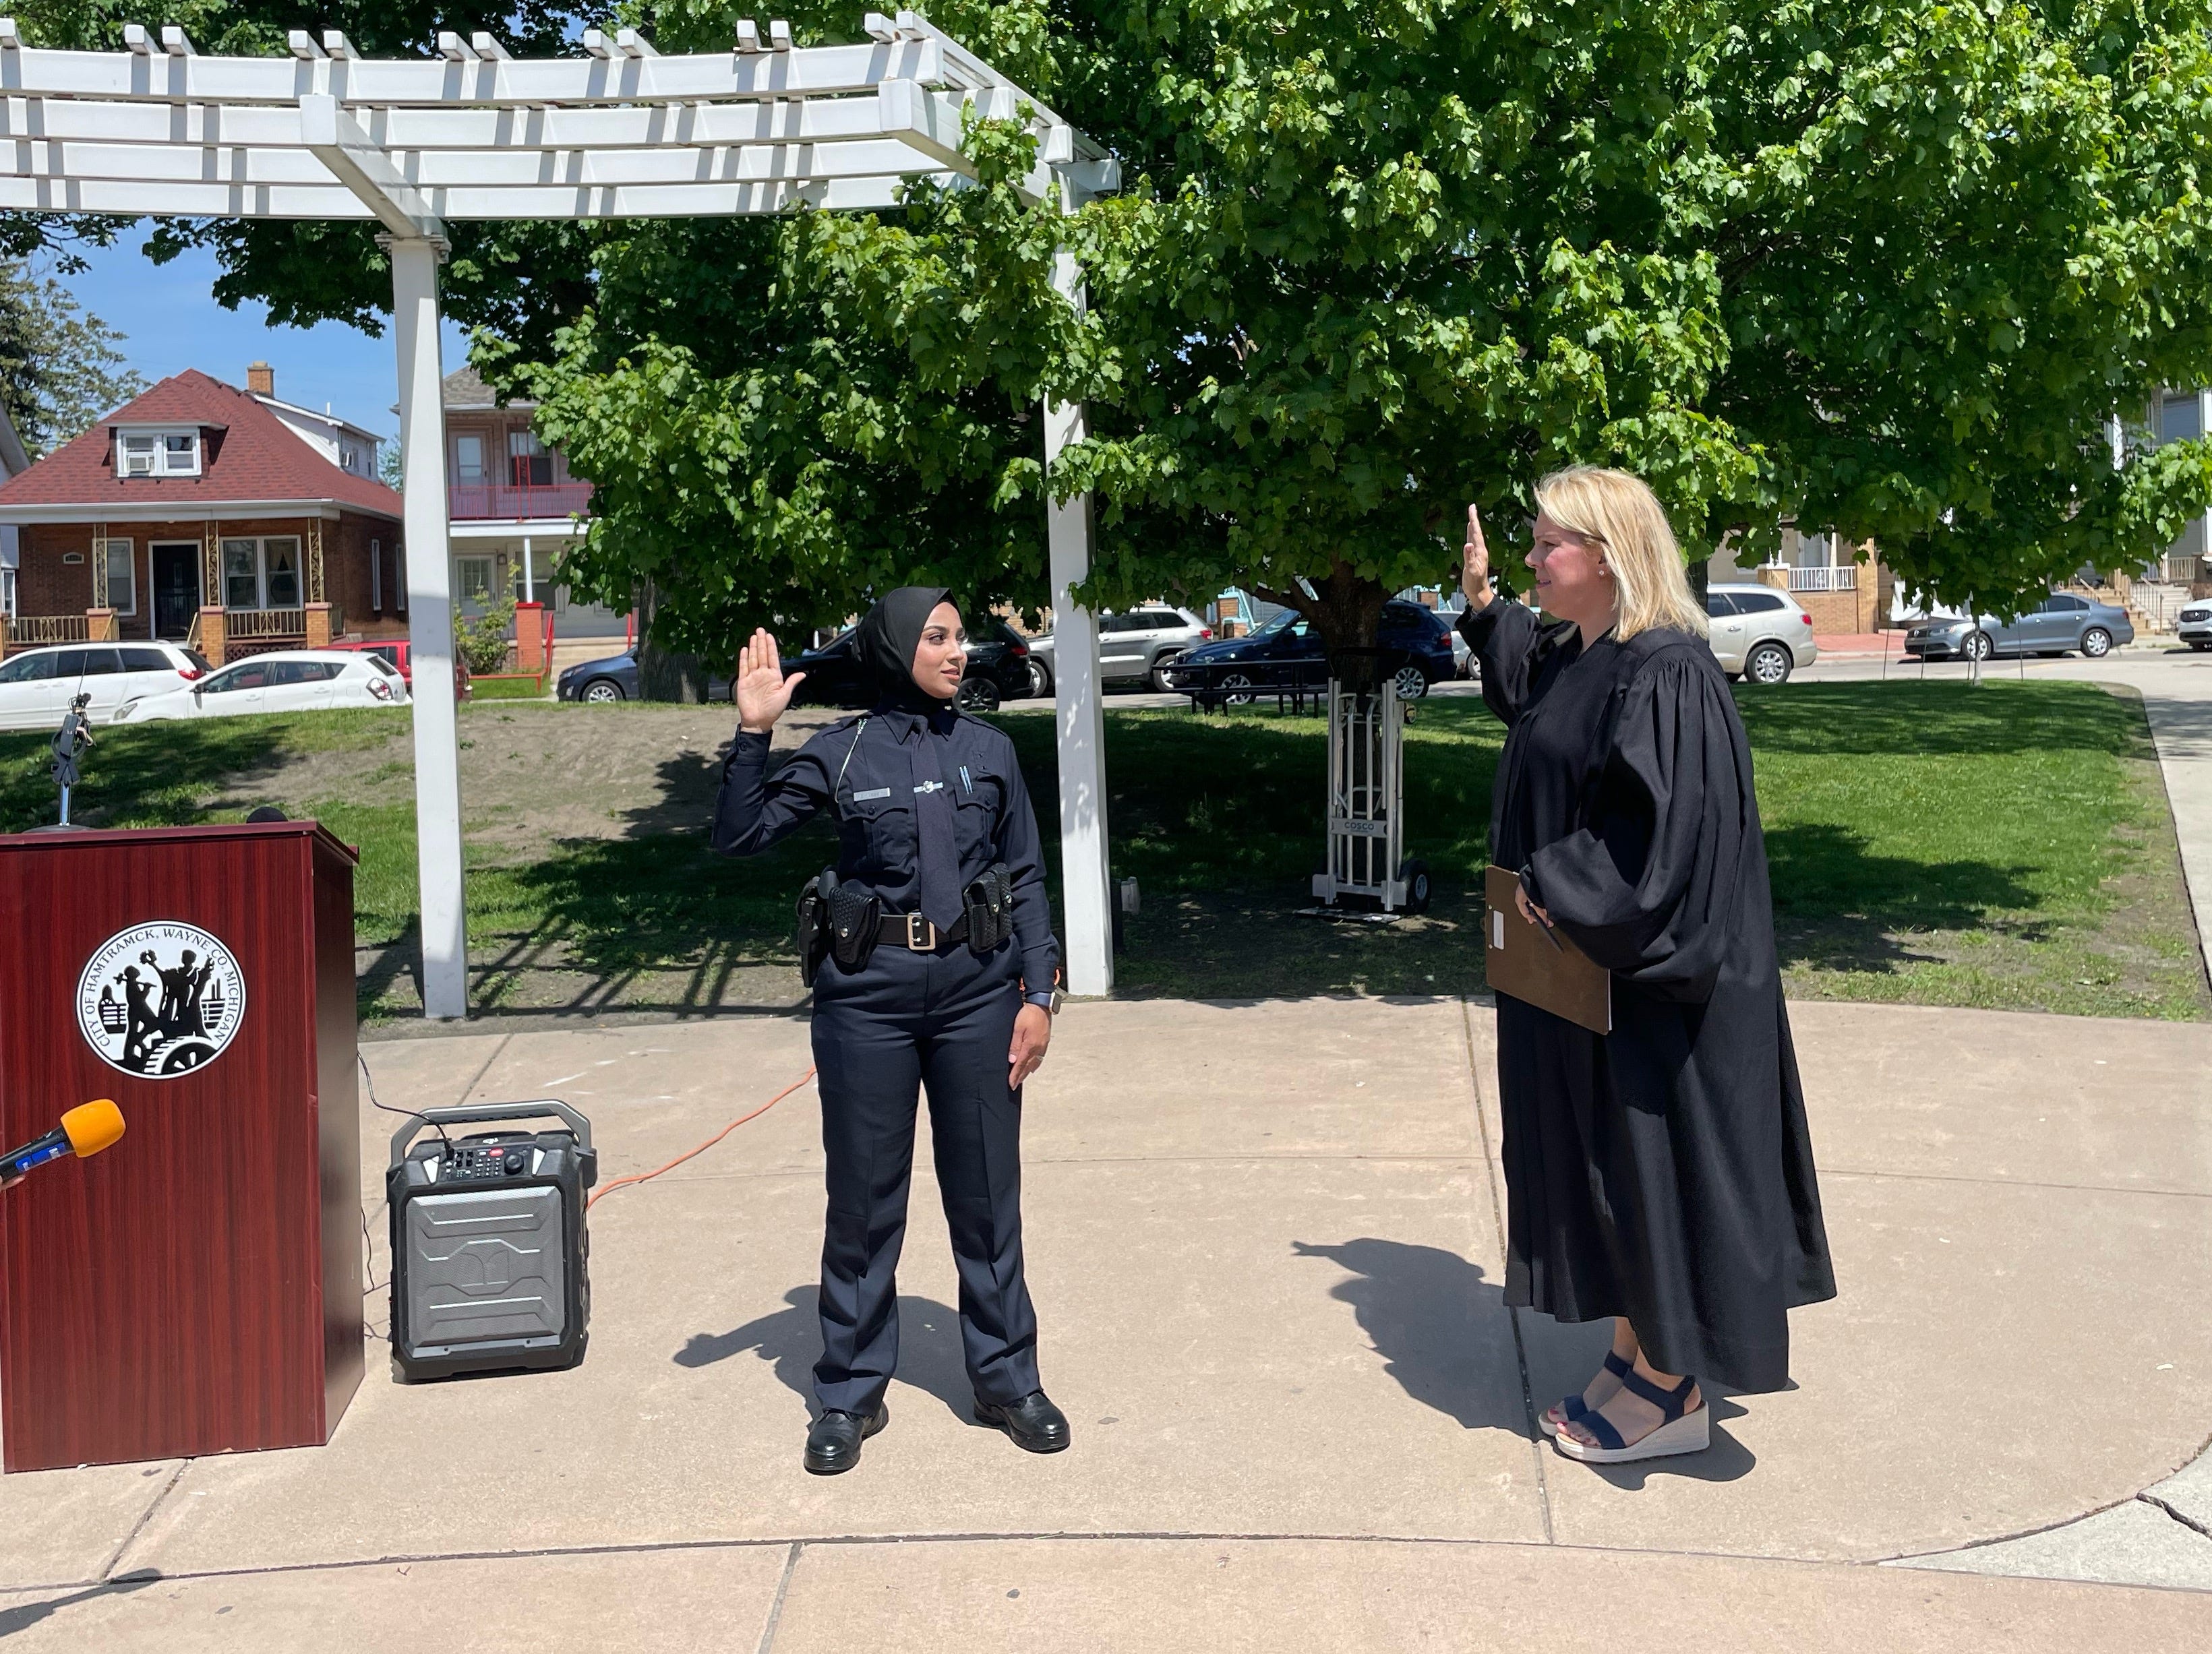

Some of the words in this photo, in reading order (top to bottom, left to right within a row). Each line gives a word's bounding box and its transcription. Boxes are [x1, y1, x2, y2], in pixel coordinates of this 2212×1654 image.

[1344, 822, 1374, 830] COSCO
[162, 927, 211, 951] WAYNE
[85, 929, 159, 993] HAMTRAMCK,
[211, 948, 228, 970] CO.
[85, 997, 96, 1014] OF
[214, 970, 239, 1042] MICHIGAN
[88, 1017, 110, 1047] CITY
